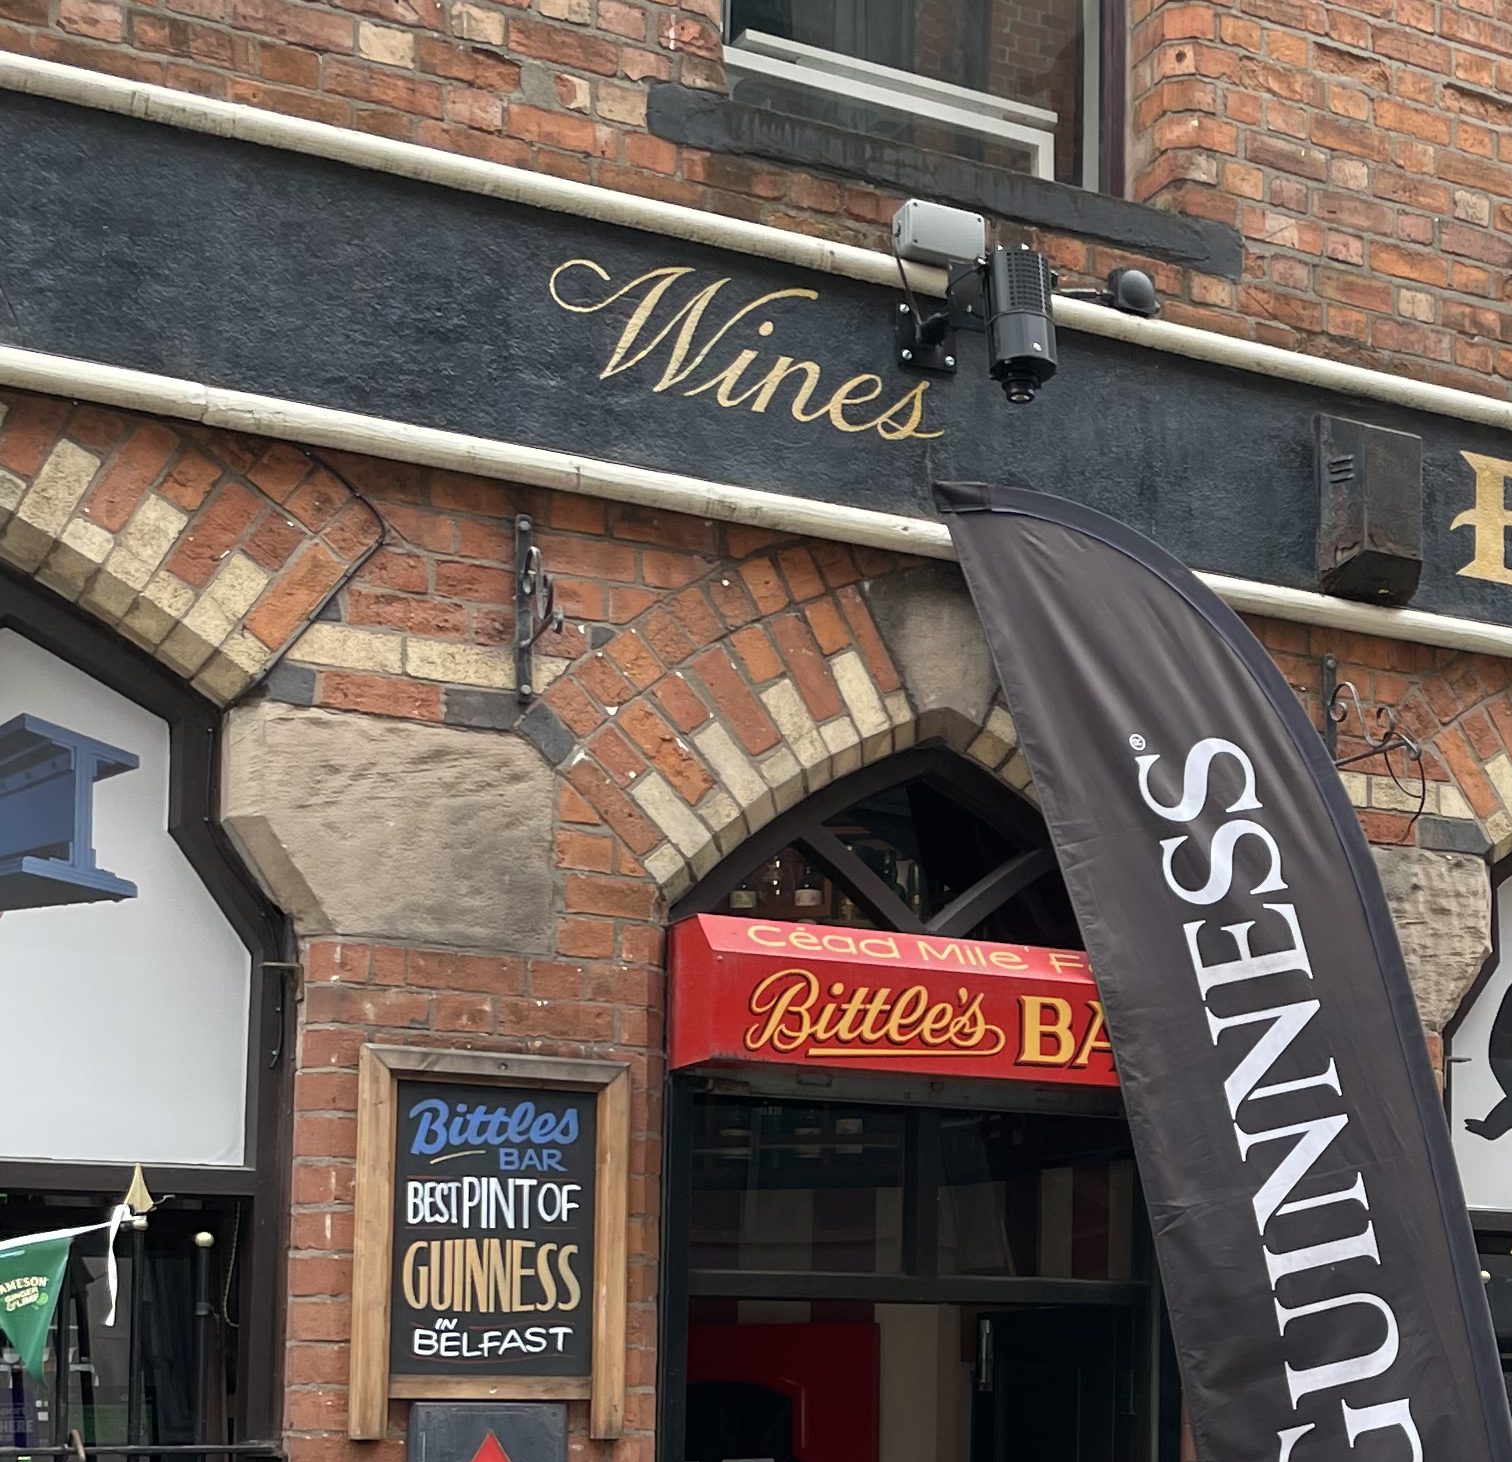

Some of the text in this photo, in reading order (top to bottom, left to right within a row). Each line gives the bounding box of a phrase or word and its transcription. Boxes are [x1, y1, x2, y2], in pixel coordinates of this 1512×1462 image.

[549, 259, 945, 441] Wines
[744, 967, 1113, 1067] Bittle's BA
[408, 1098, 580, 1155] Bittles
[499, 1148, 569, 1172] BAR
[406, 1176, 582, 1229] BEST PINT OF
[0, 1276, 49, 1295] AMESON
[402, 1238, 582, 1313] GUINNESS
[413, 1327, 574, 1357] BELFAST
[435, 1317, 458, 1330] IN
